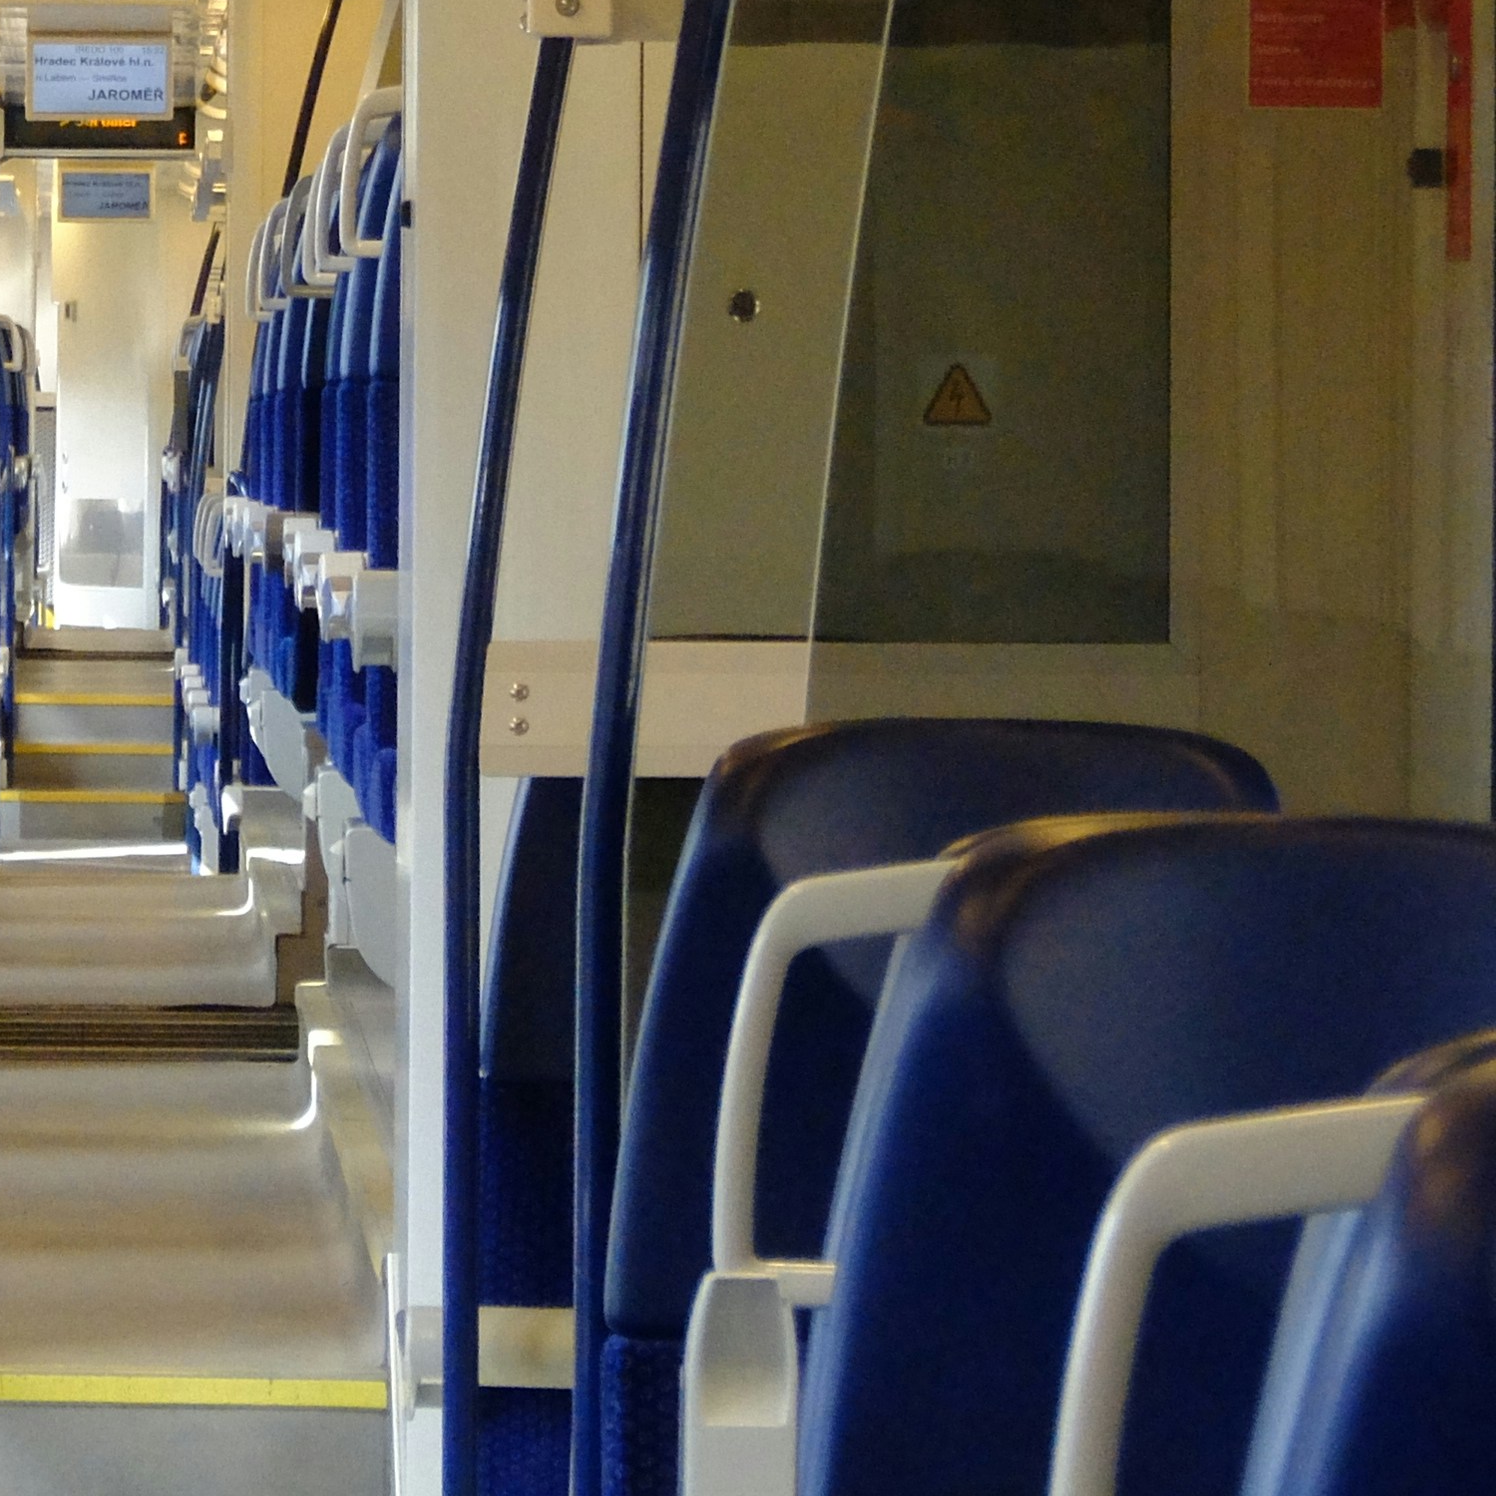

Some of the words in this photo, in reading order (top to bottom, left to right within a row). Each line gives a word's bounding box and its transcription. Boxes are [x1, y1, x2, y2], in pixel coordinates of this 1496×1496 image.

[34, 56, 77, 67] Hradec
[80, 56, 126, 67] Králové
[88, 88, 164, 102] JAROMĚŘ
